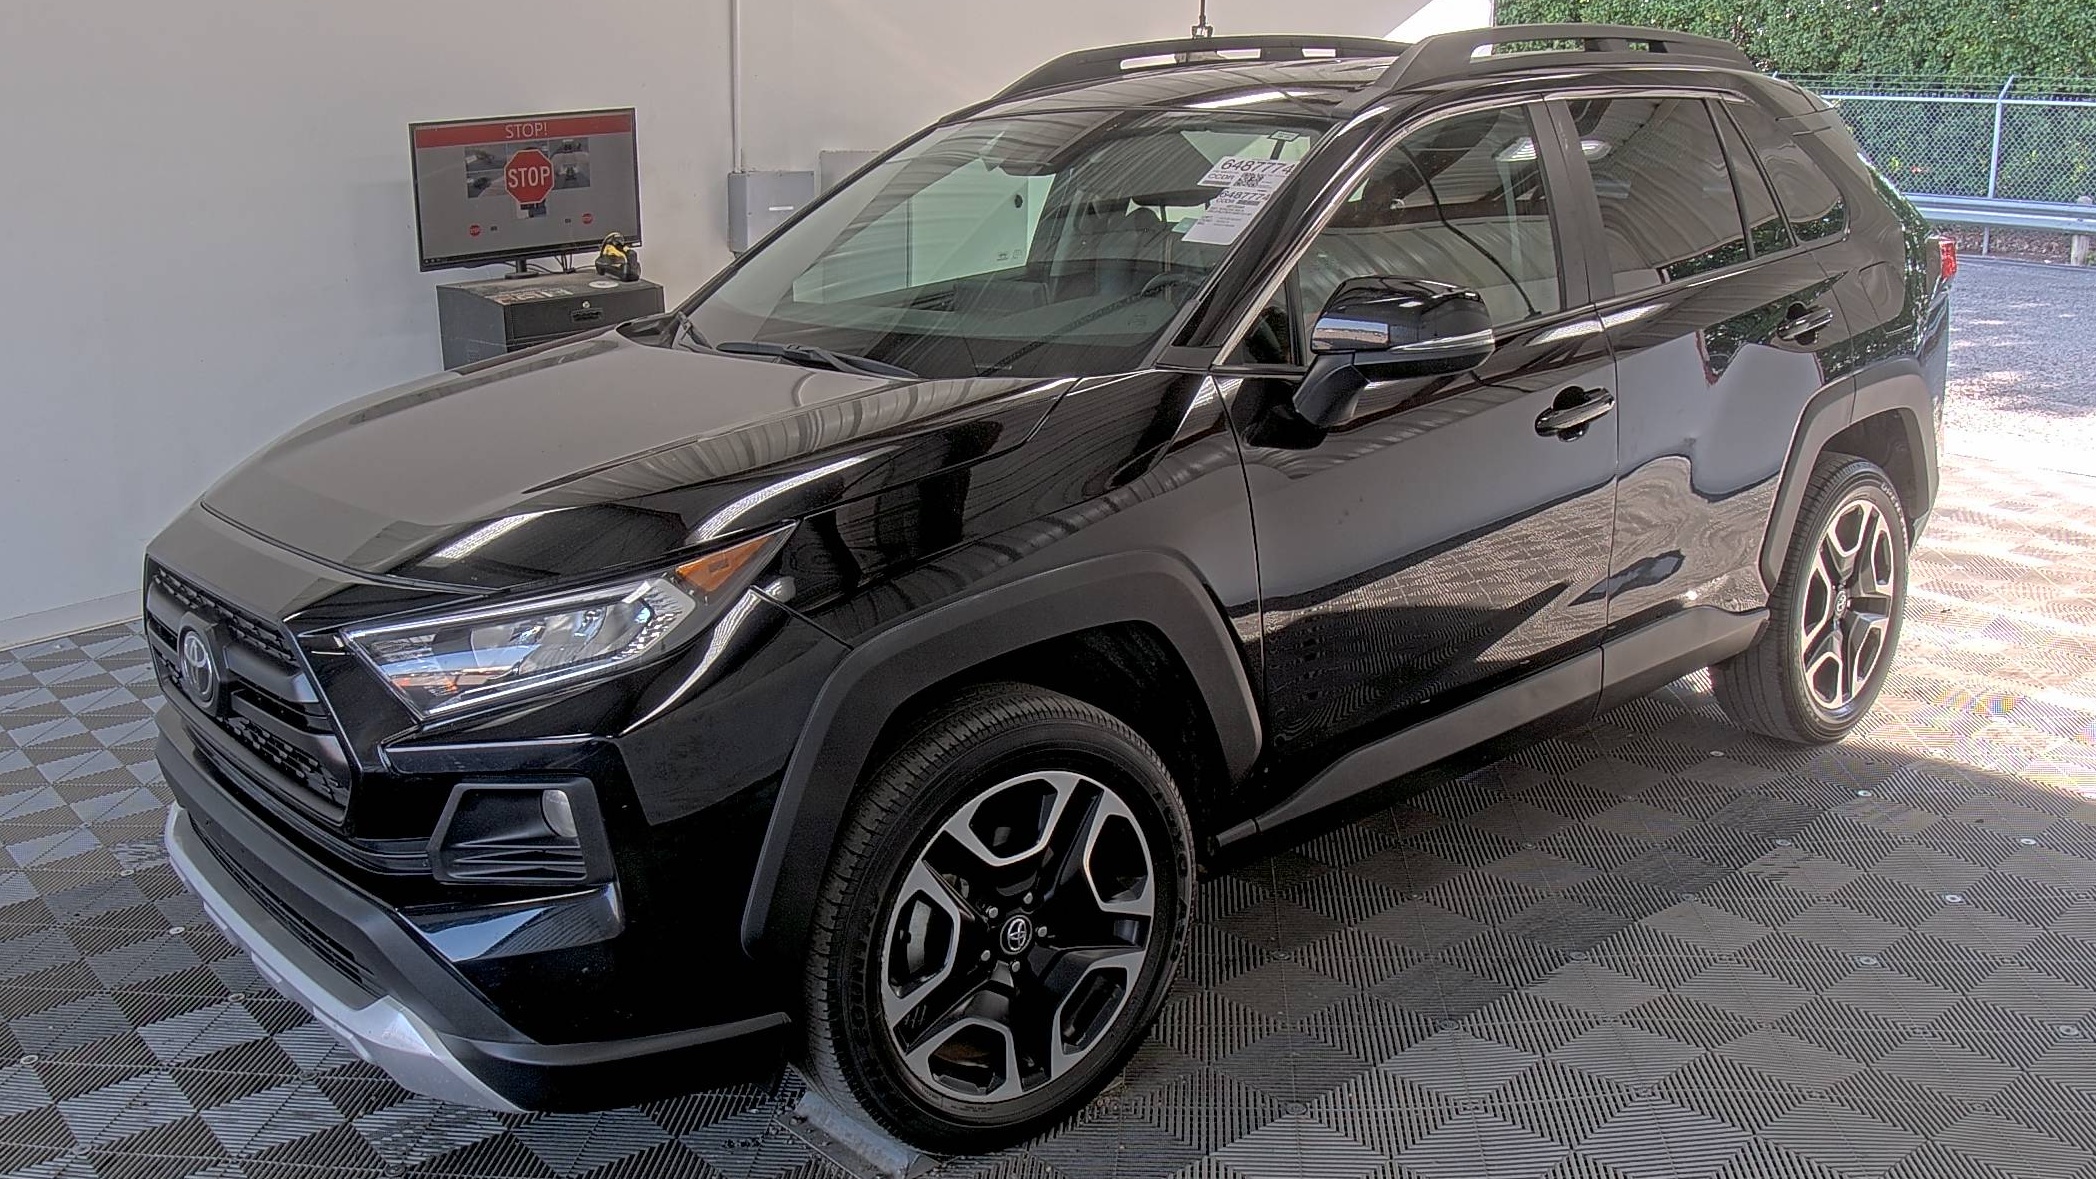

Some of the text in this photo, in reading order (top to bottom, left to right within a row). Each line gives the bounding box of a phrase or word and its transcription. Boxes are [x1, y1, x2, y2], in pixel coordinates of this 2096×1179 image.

[505, 122, 548, 139] STOP!
[1221, 158, 1296, 174] 6487774
[508, 166, 551, 188] STOP
